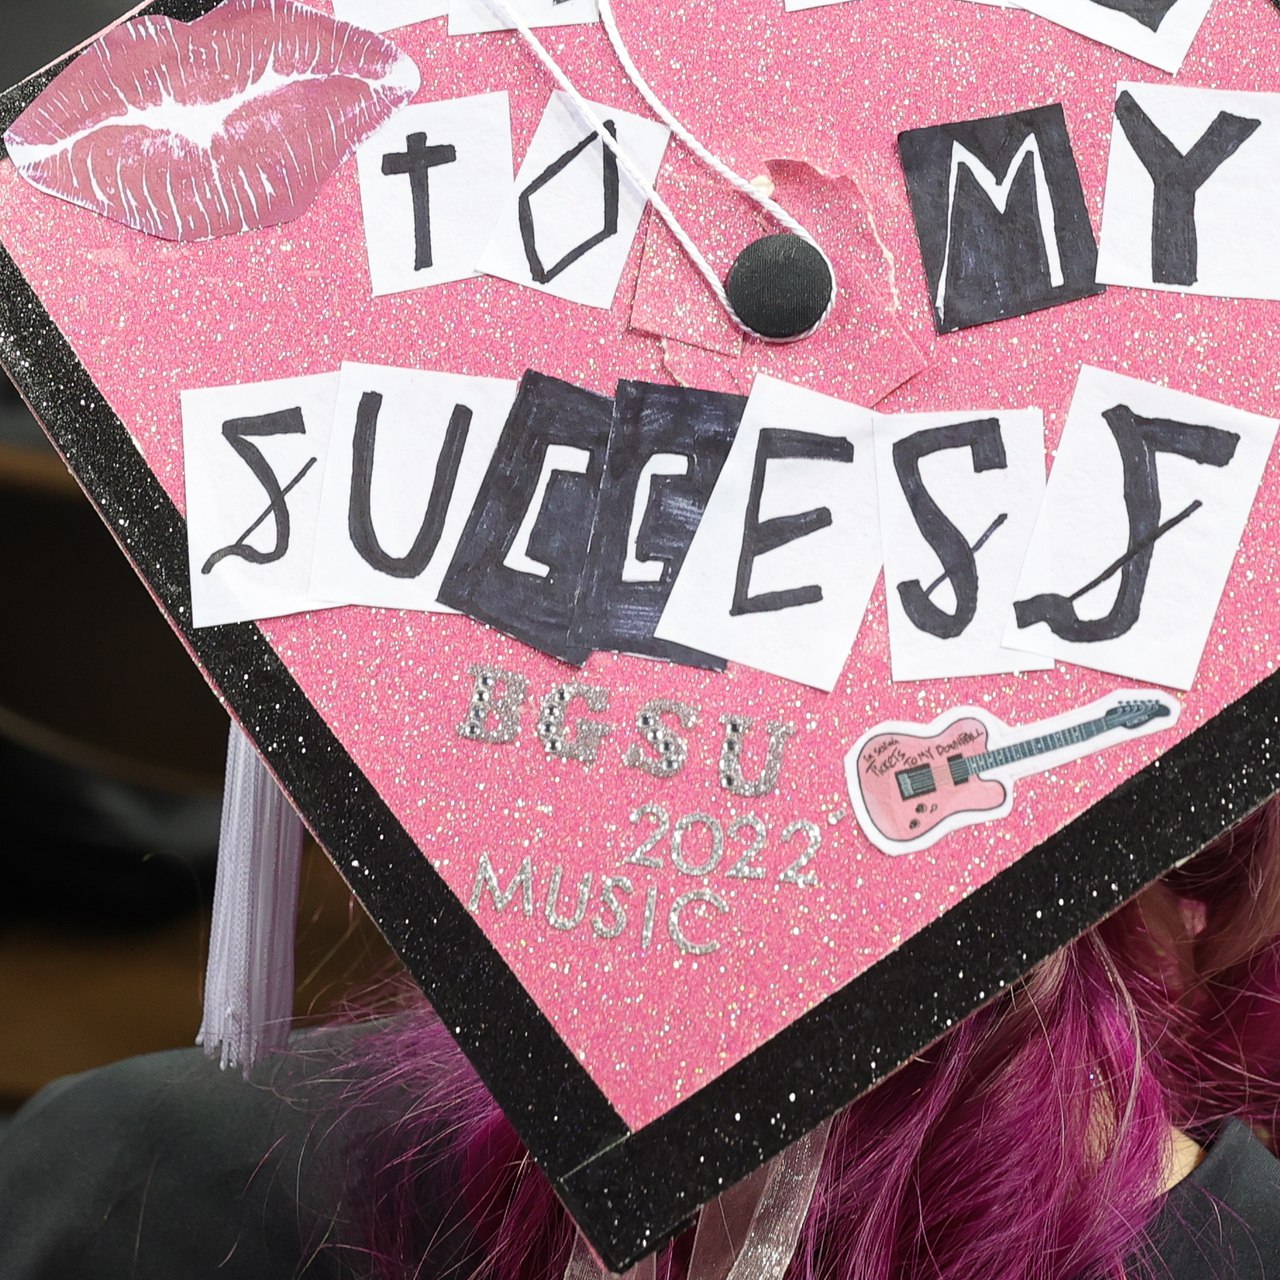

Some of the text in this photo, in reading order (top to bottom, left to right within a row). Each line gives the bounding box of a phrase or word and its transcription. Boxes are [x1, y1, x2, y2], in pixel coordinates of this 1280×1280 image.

[381, 90, 1262, 320] TO MY
[201, 390, 1241, 642] SUCCESS
[455, 663, 796, 798] BGSU
[903, 756, 918, 768] TO
[917, 746, 935, 761] MY
[467, 851, 730, 955] MUSIC
[624, 804, 822, 886] 2022
